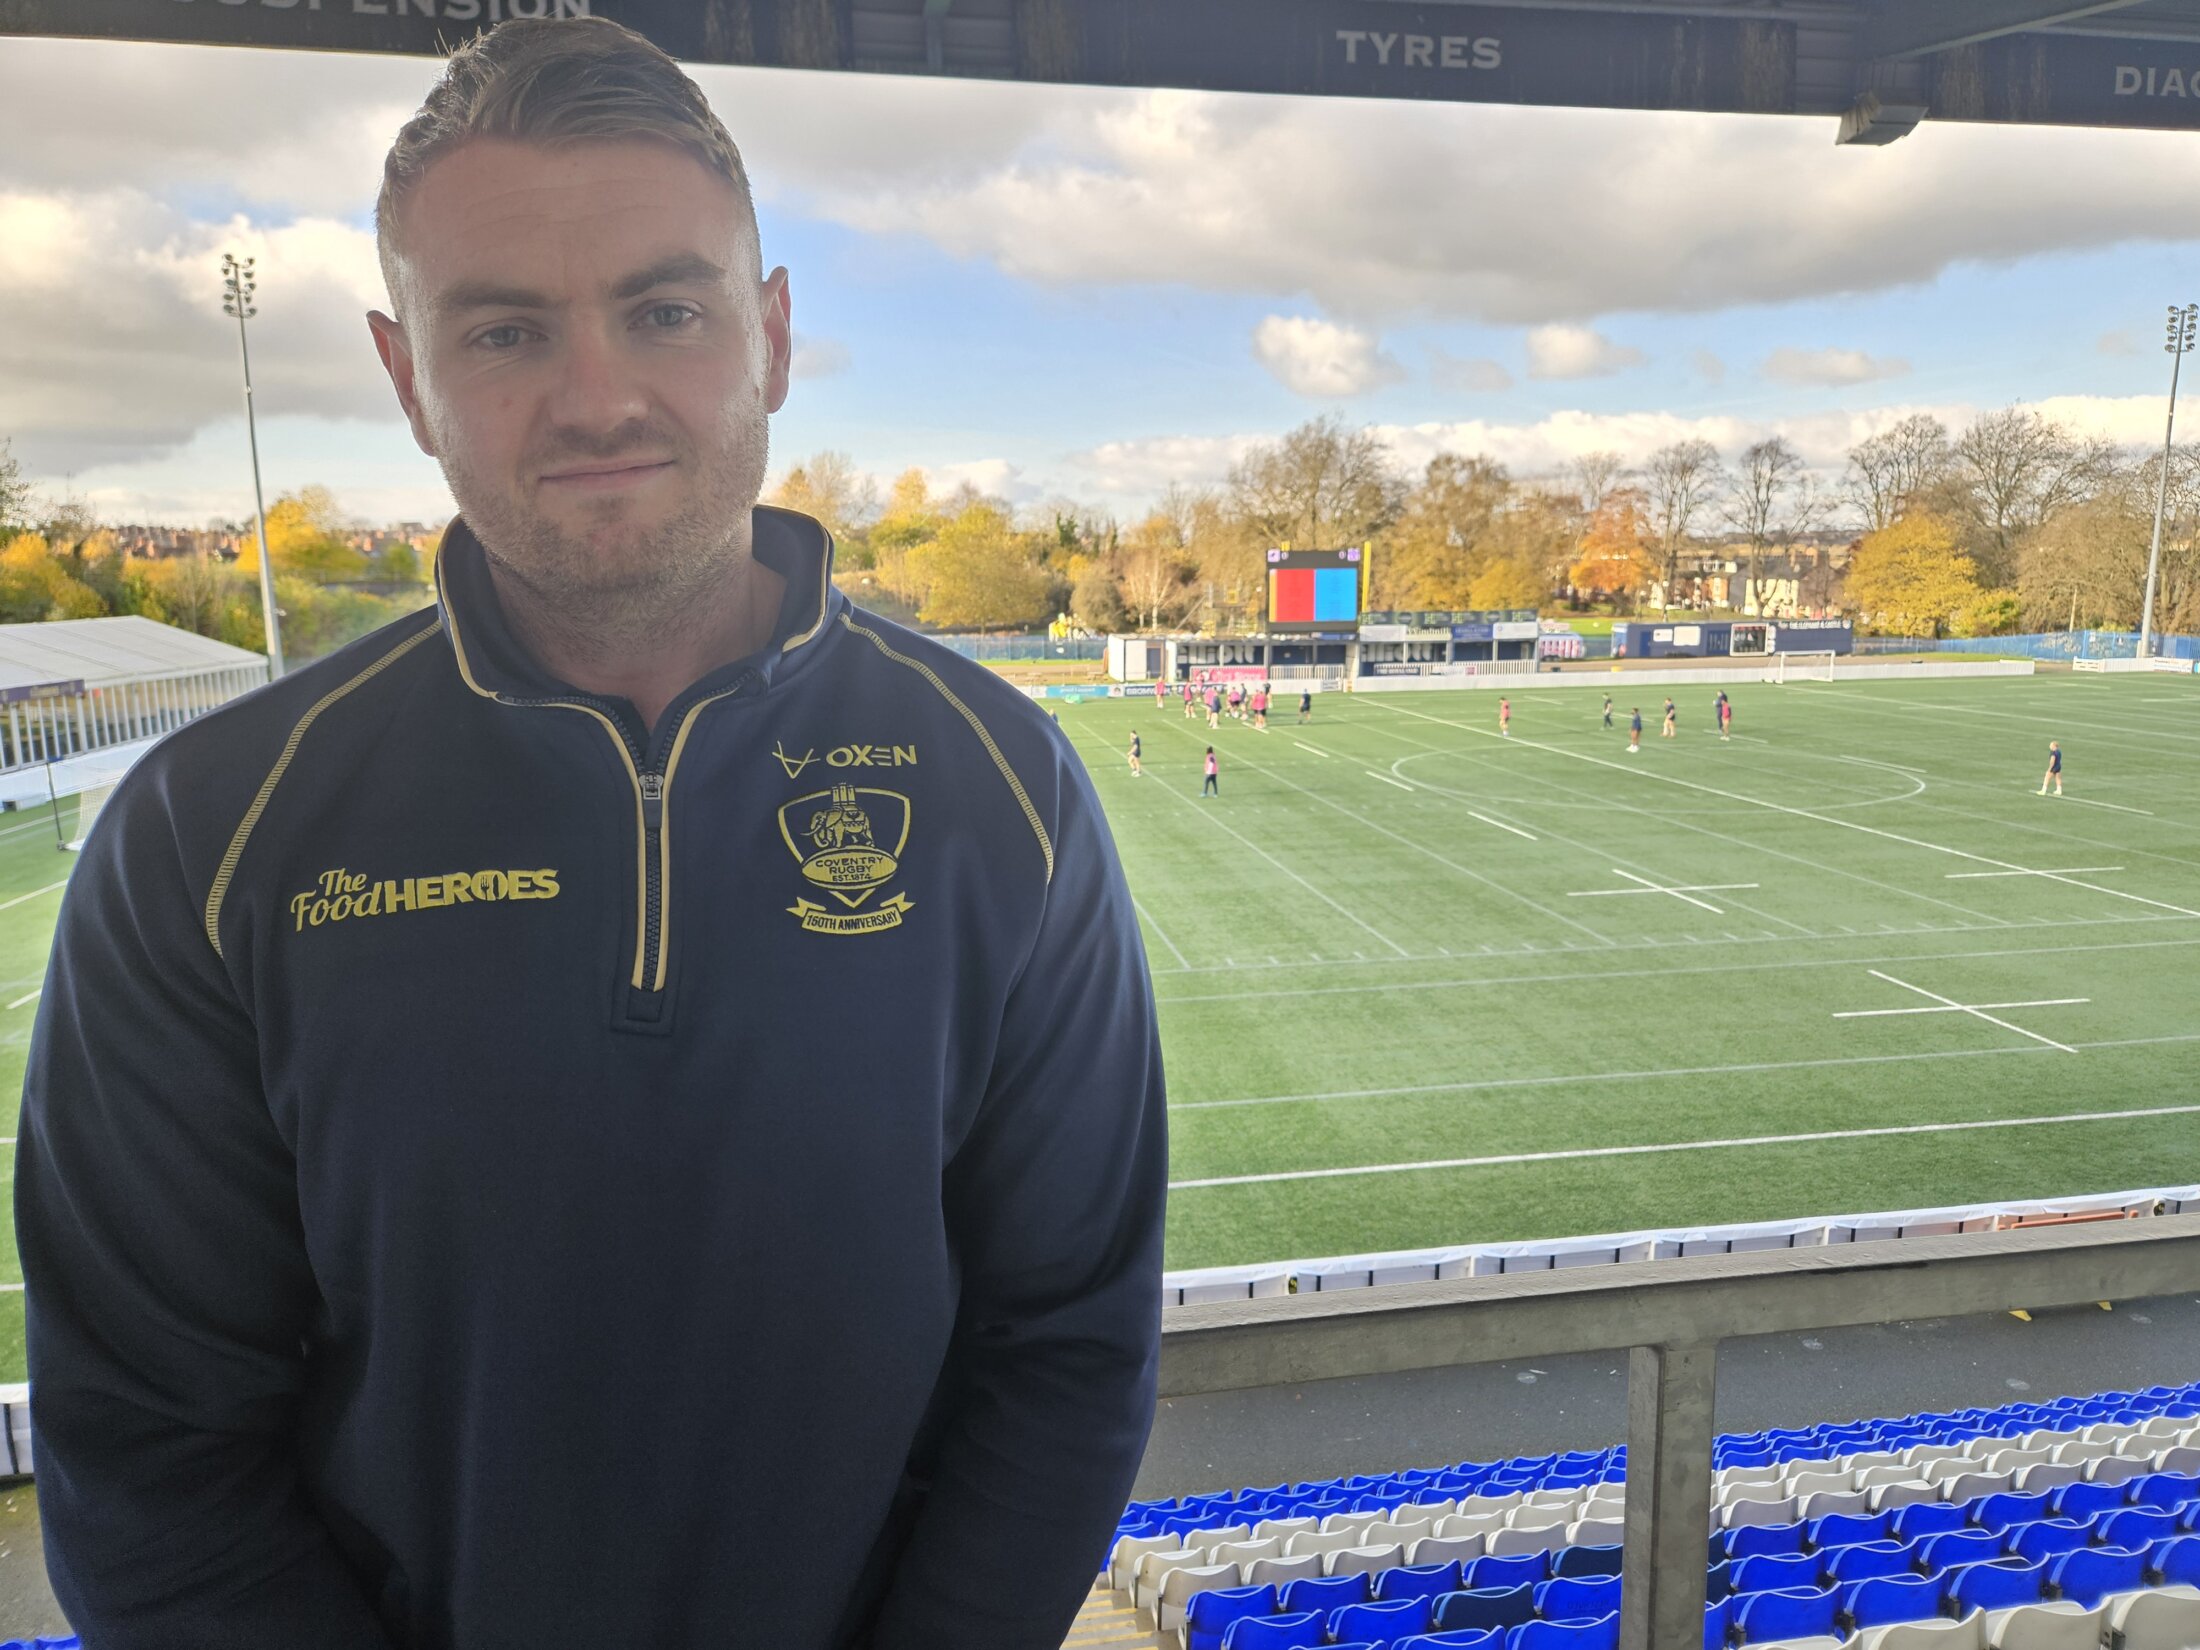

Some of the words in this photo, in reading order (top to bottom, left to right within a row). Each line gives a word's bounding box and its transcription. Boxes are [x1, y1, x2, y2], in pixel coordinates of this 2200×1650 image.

[1336, 30, 1501, 70] TYRES
[825, 744, 918, 767] OXEN
[815, 856, 884, 868] COVENTRY
[829, 864, 873, 875] RUGBY
[319, 868, 367, 896] The
[838, 910, 898, 931] ANNIVERSARY
